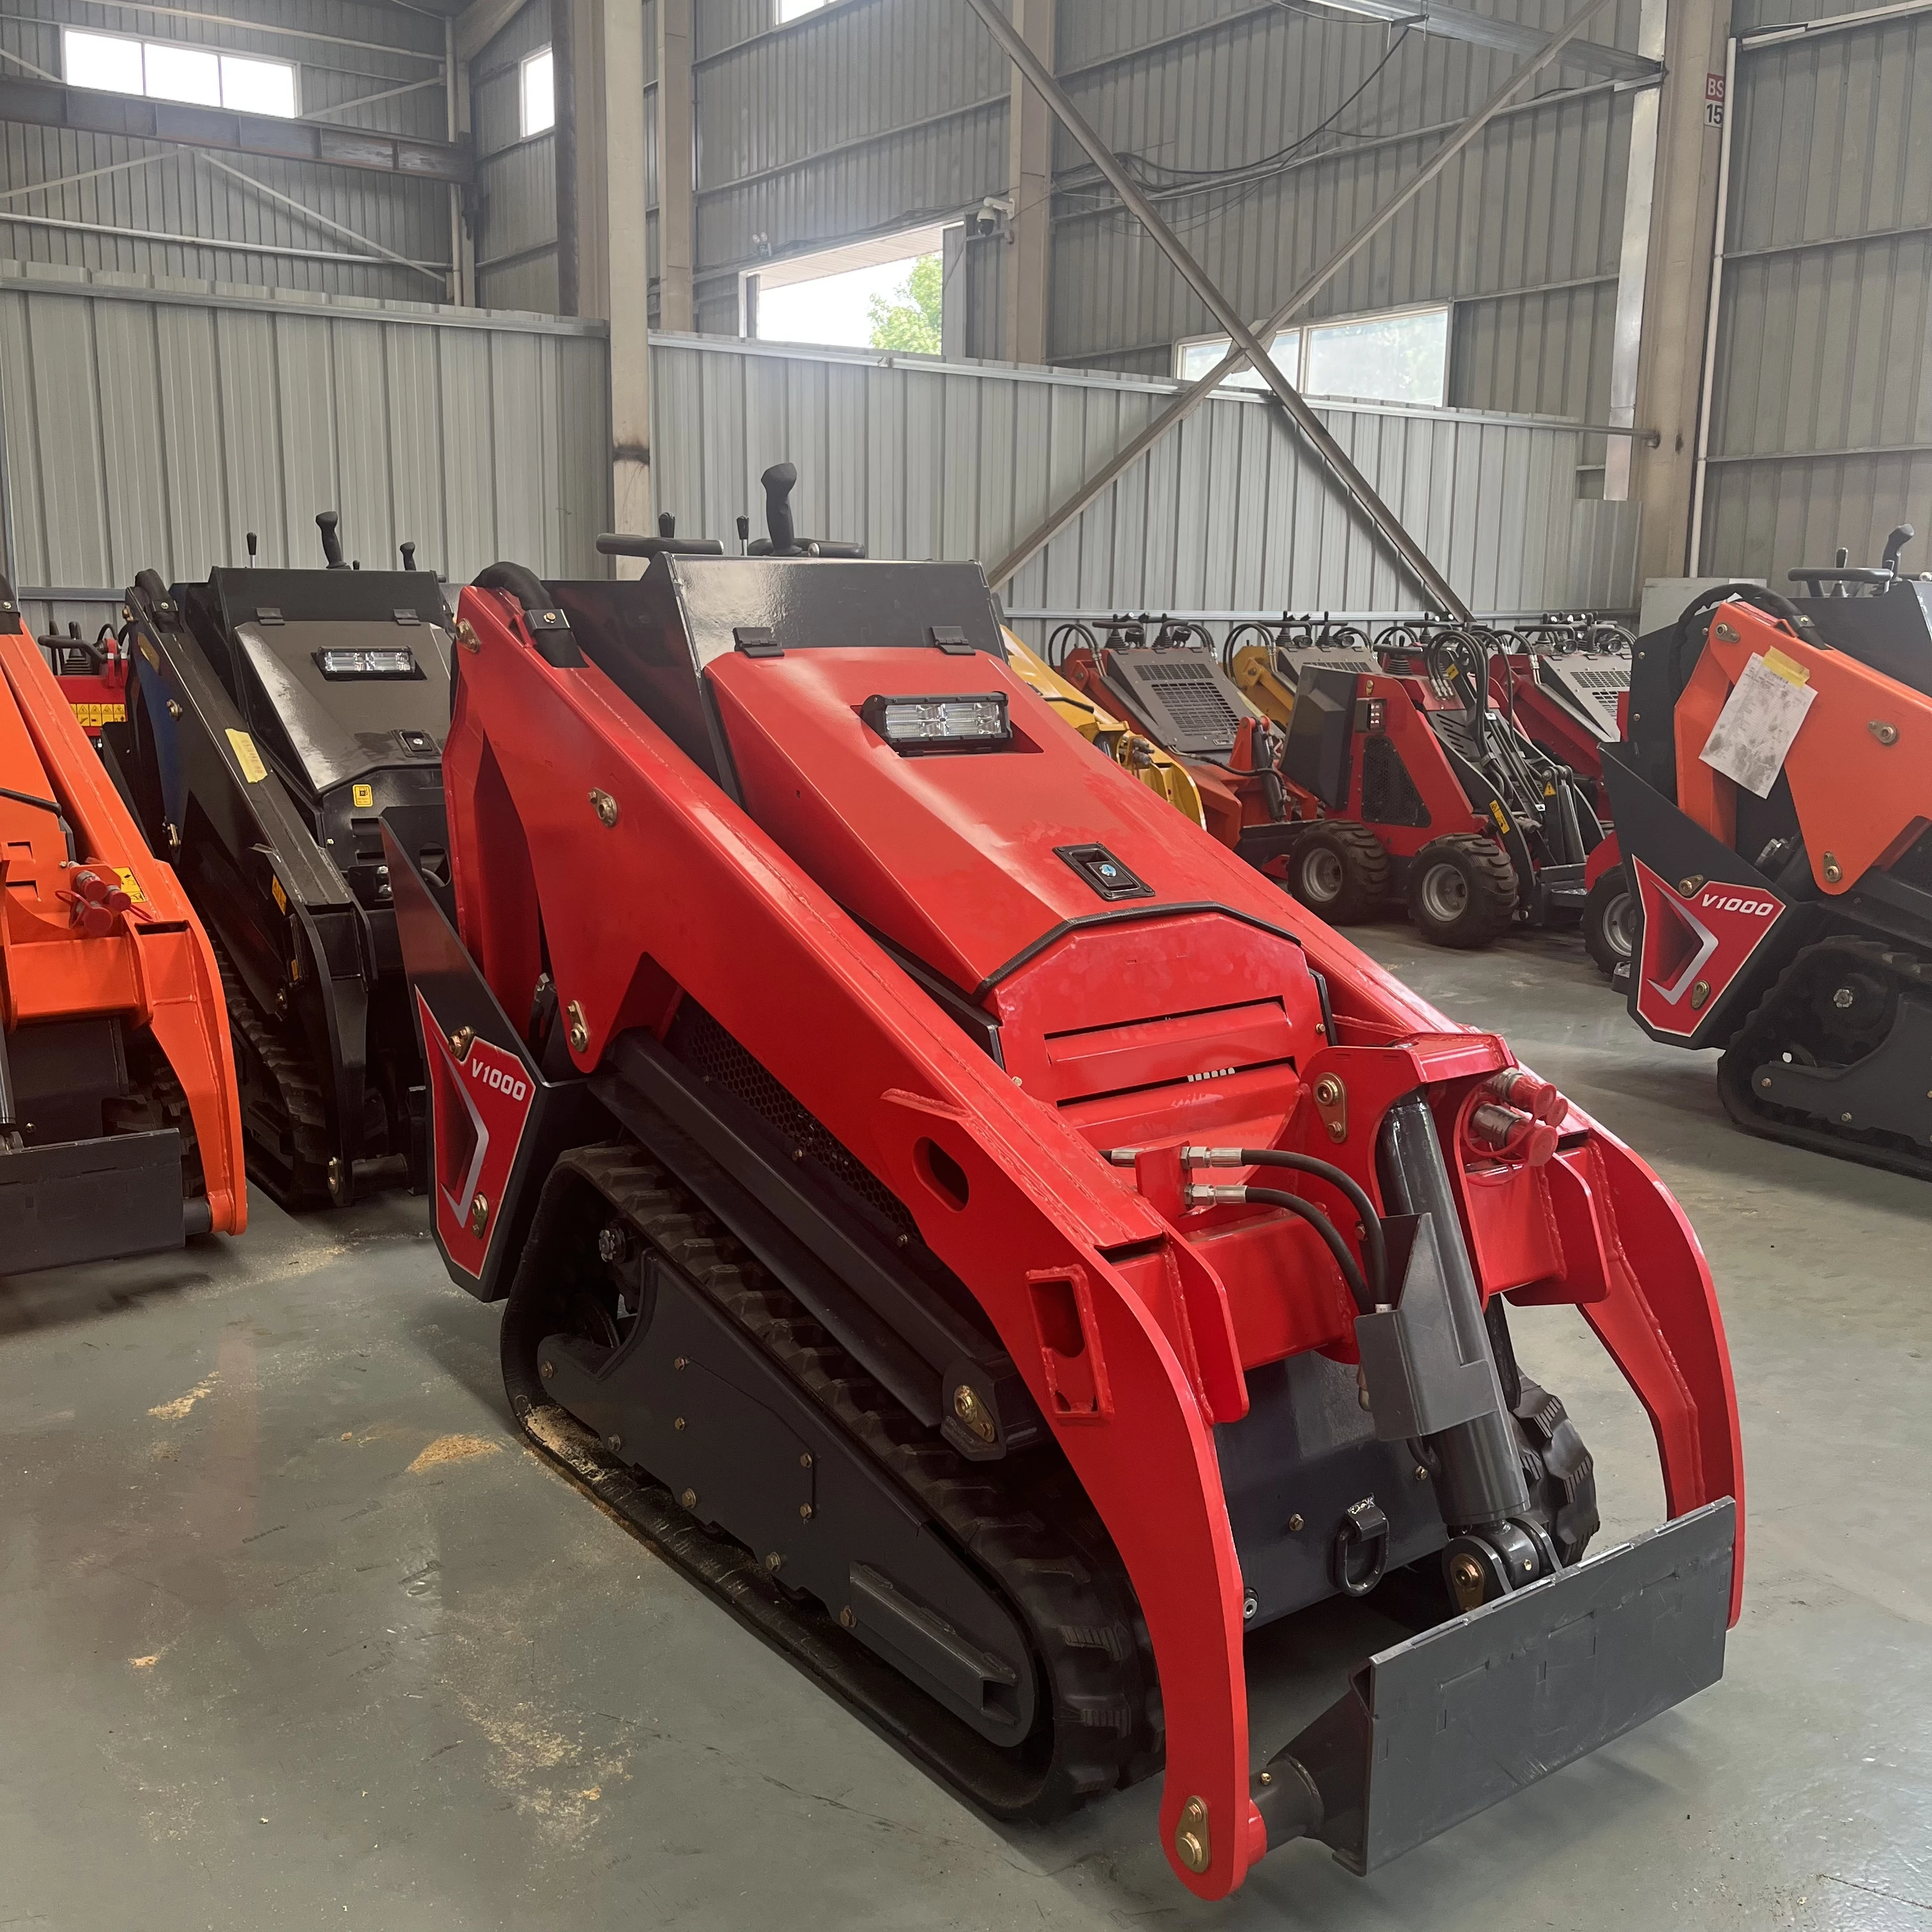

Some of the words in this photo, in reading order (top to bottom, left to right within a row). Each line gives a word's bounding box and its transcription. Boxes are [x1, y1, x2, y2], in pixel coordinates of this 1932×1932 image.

[1708, 78, 1724, 98] BS
[1706, 103, 1723, 125] 15
[1702, 894, 1774, 916] V1000
[471, 1058, 526, 1101] V1000
